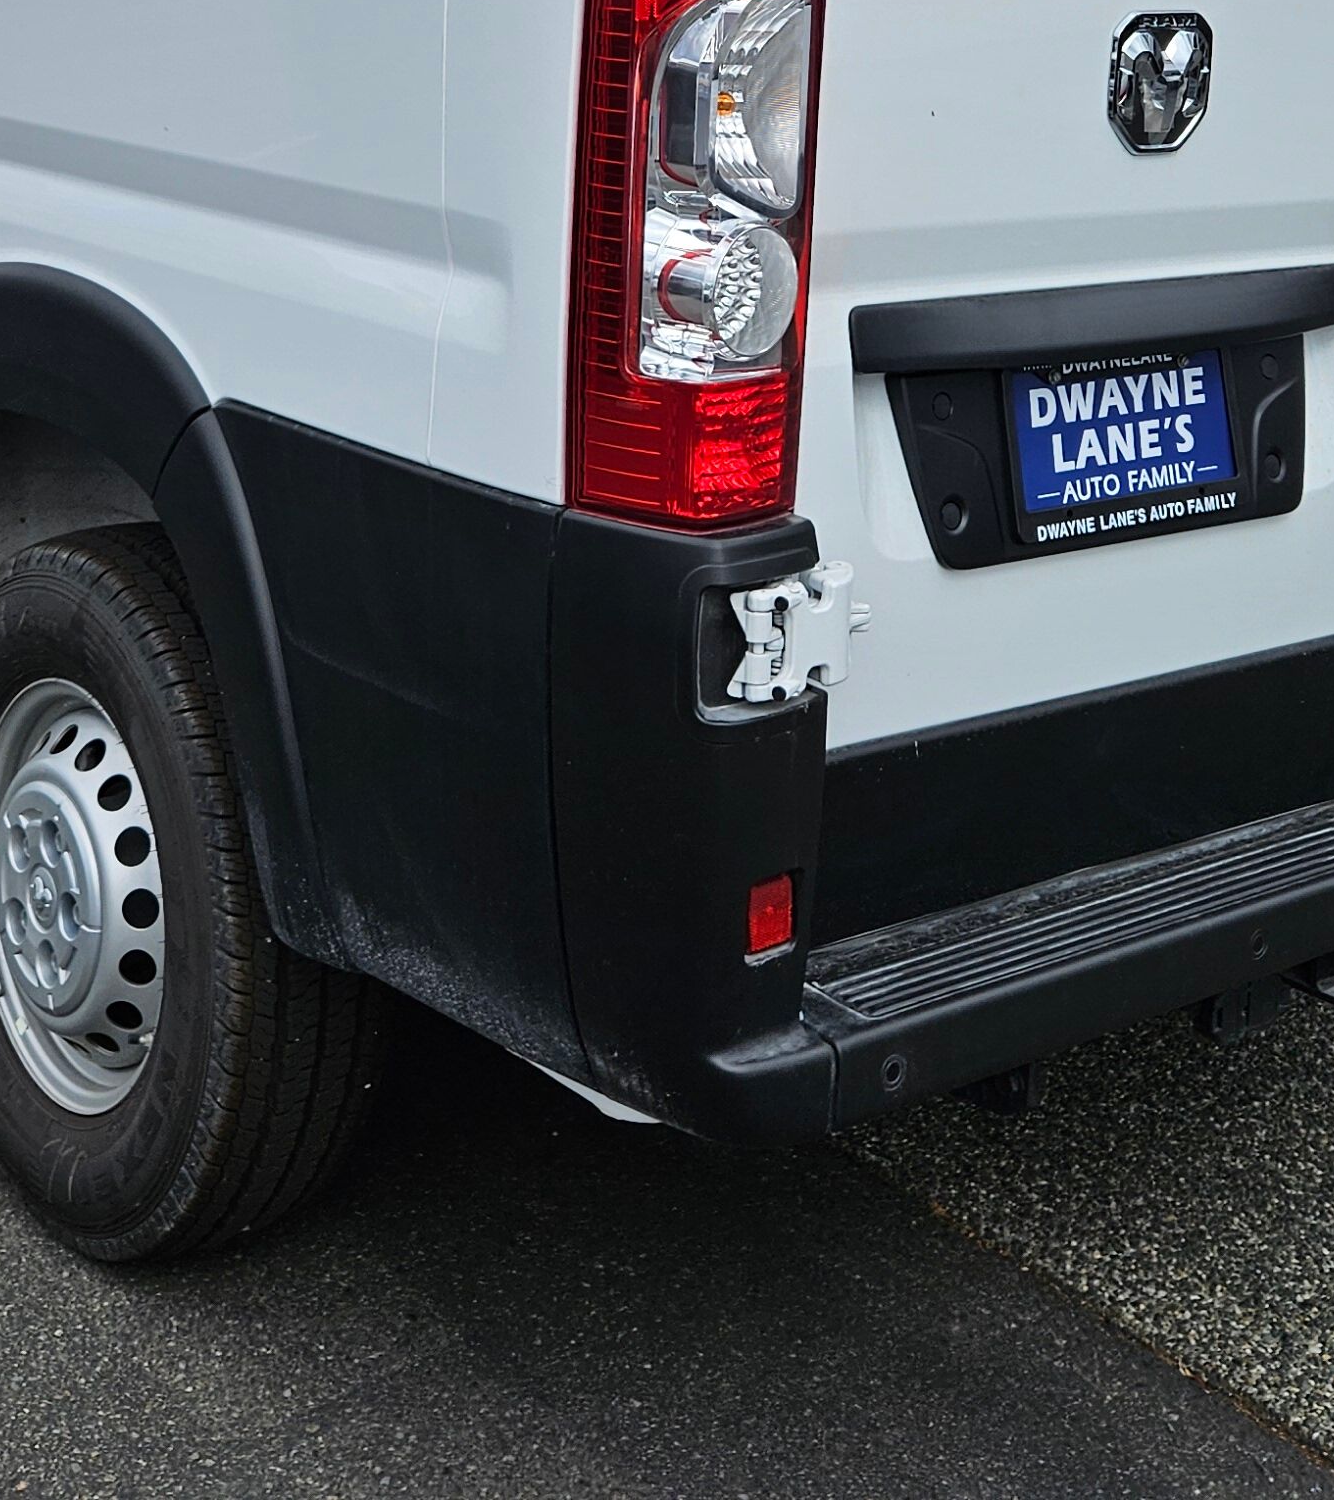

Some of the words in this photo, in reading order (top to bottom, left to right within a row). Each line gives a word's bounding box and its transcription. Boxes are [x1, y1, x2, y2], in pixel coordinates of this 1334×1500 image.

[1028, 366, 1206, 428] DWAYNE
[1051, 414, 1195, 473] LANE'S
[1062, 474, 1120, 504] AUTO
[1127, 461, 1195, 492] FAMILY
[1037, 517, 1096, 542] DWAYNE
[1099, 508, 1146, 530] LANE'S
[1150, 502, 1185, 522] AUTO
[1187, 492, 1237, 515] FAMILY
